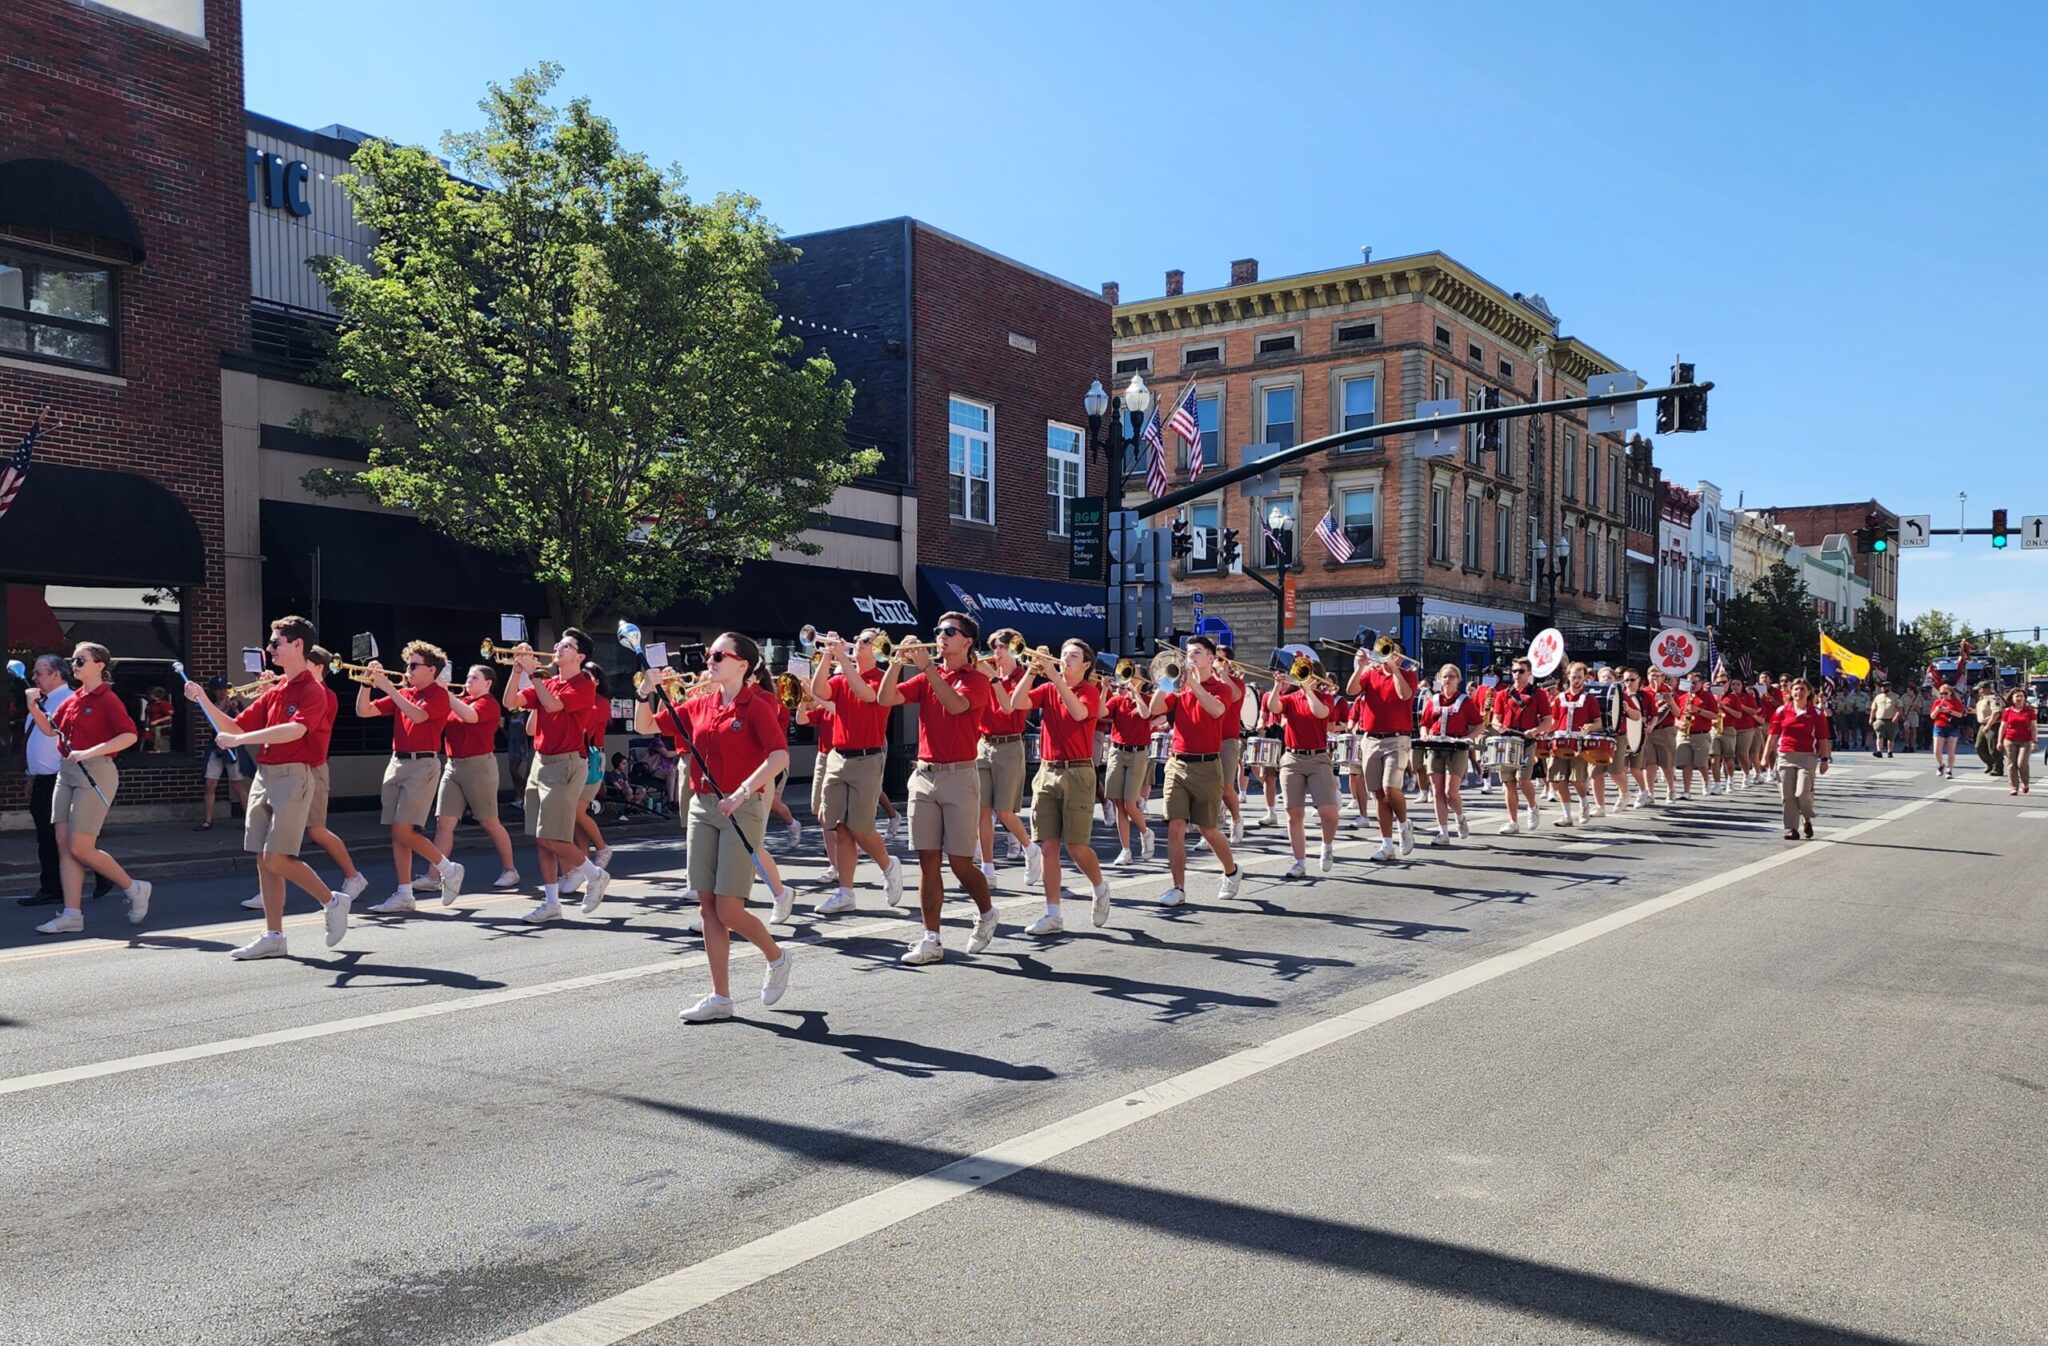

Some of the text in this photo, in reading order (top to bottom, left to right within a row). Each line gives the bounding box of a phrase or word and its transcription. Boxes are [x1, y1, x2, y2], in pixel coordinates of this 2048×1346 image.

[2025, 539, 2048, 547] ONLY
[1073, 552, 1094, 560] College
[977, 593, 1019, 612] Armed
[1015, 597, 1057, 615] Forces
[1462, 623, 1488, 640] CHASE
